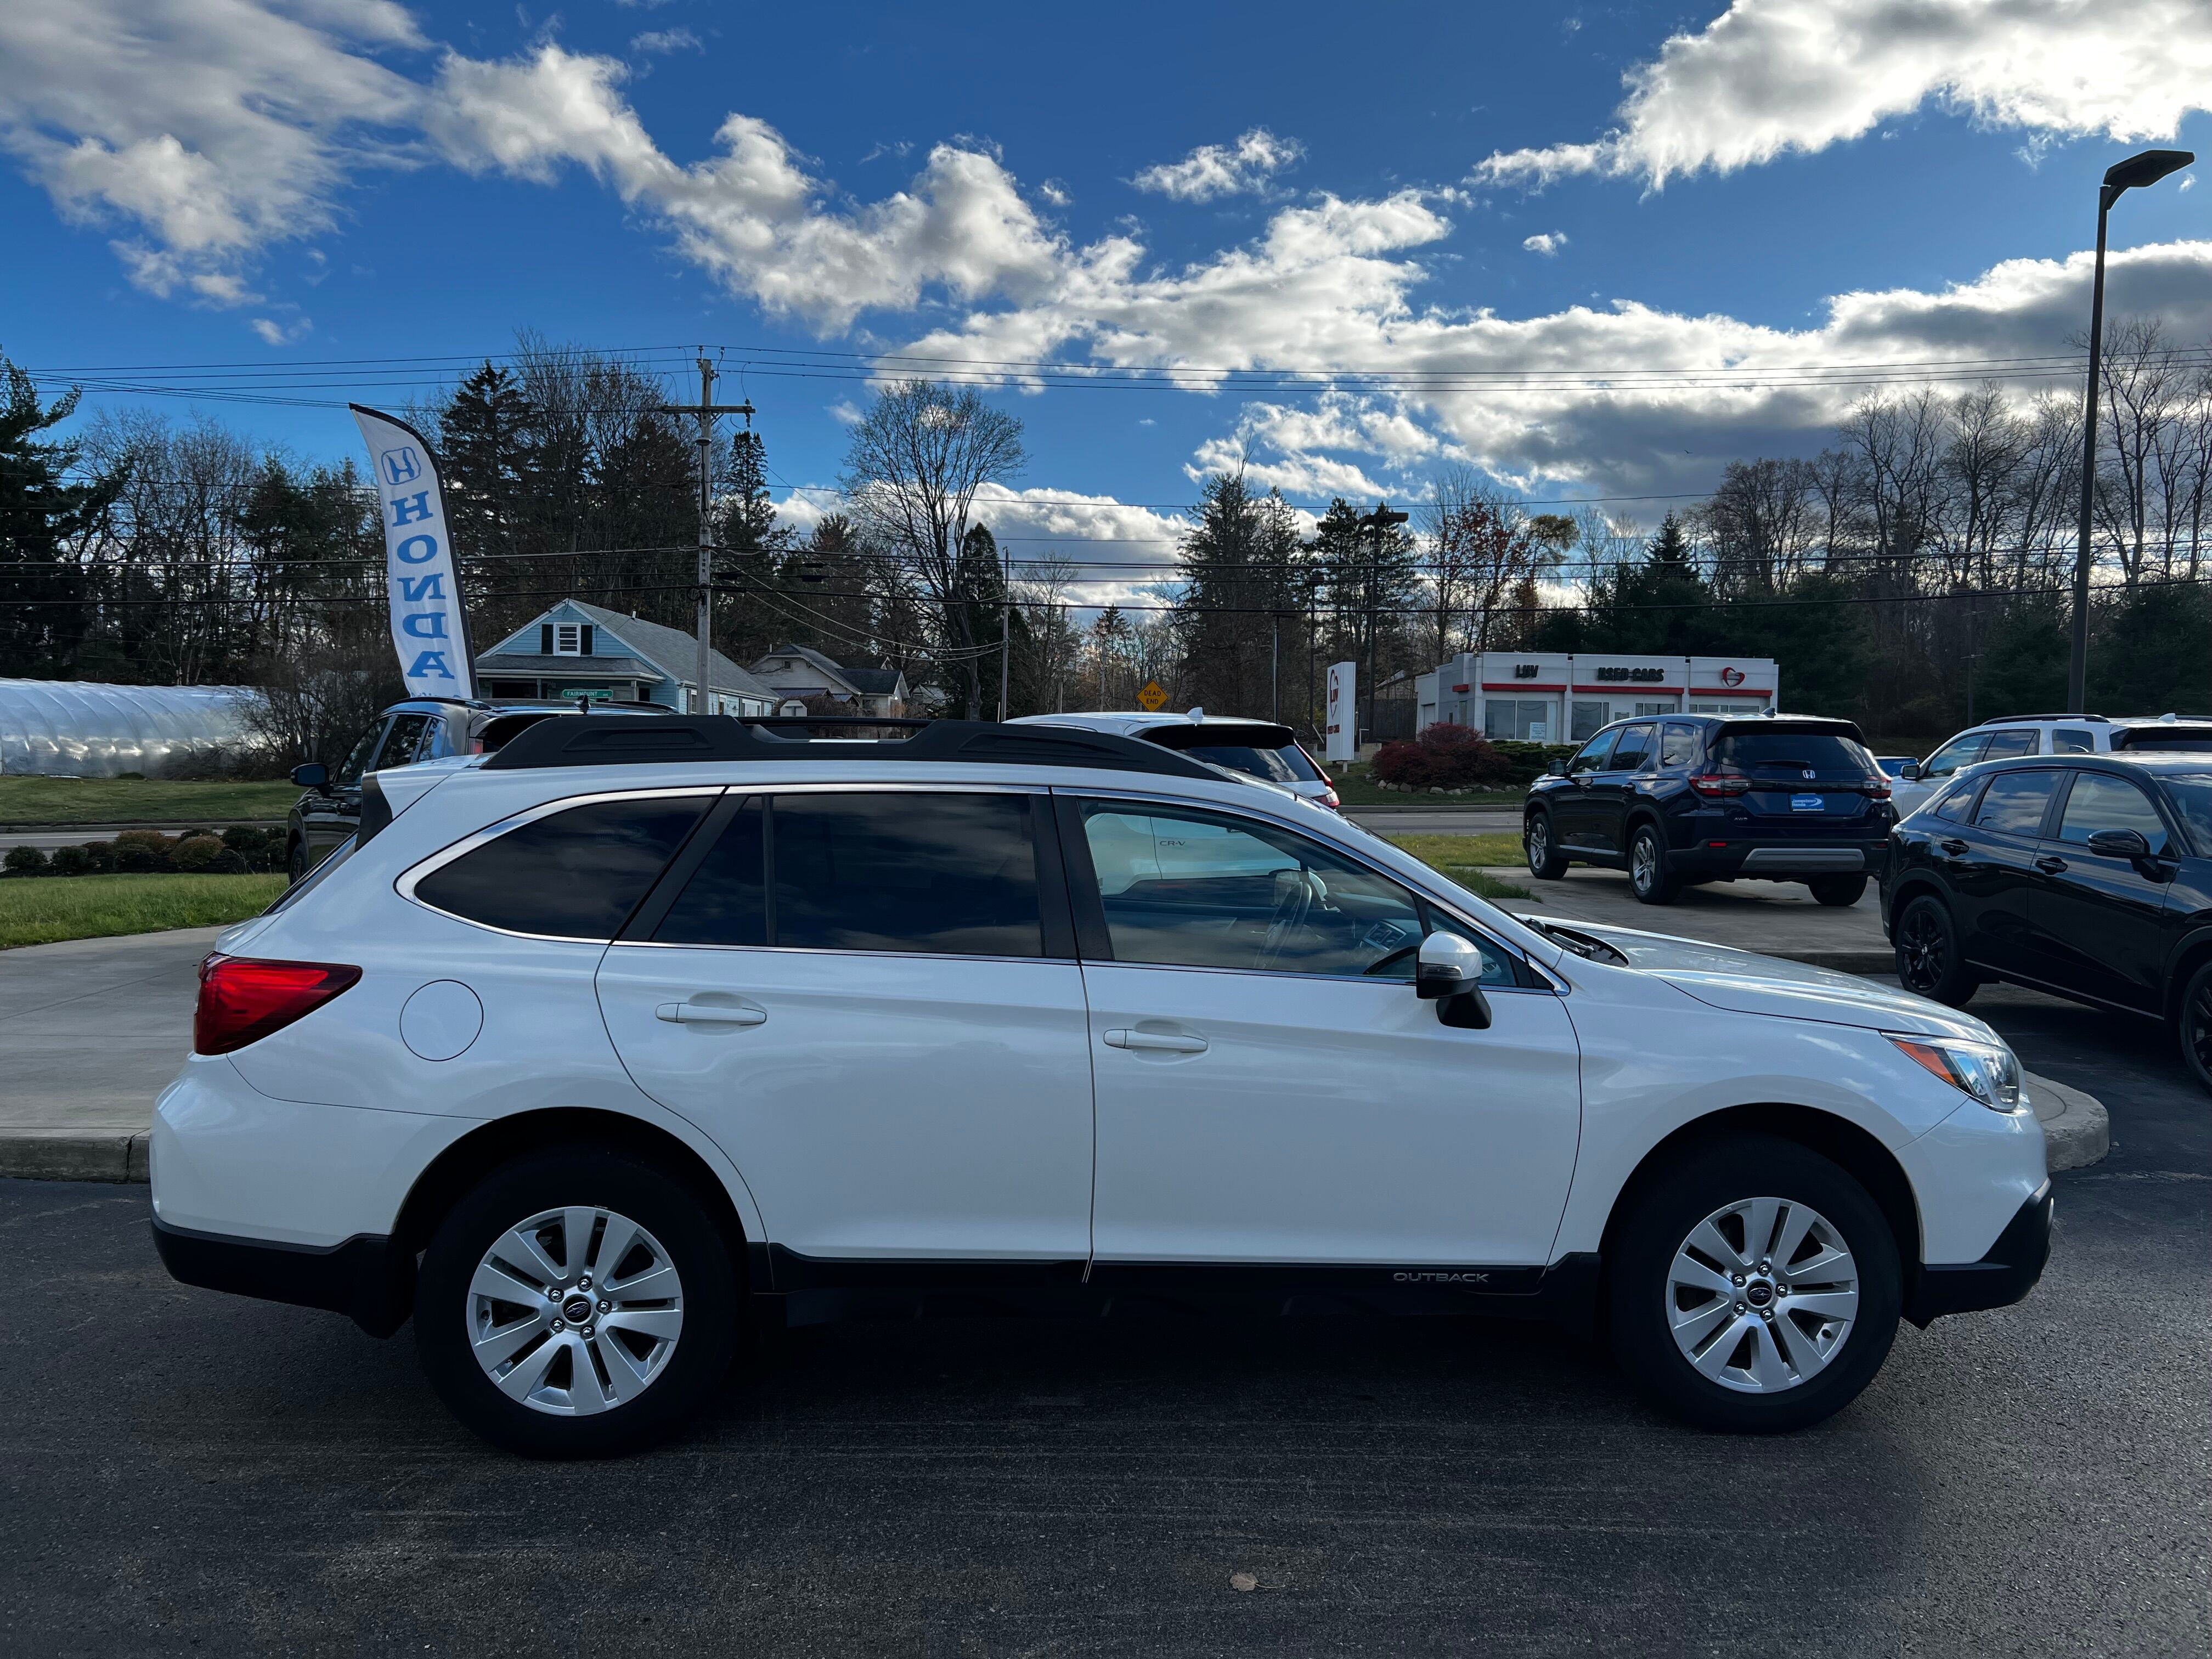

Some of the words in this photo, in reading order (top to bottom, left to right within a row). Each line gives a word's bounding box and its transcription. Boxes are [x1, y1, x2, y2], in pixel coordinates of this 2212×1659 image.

[1516, 664, 1538, 678] LUV
[1598, 667, 1628, 681] USED
[1633, 668, 1664, 682] CARS
[1393, 1272, 1489, 1283] OUTBACK
